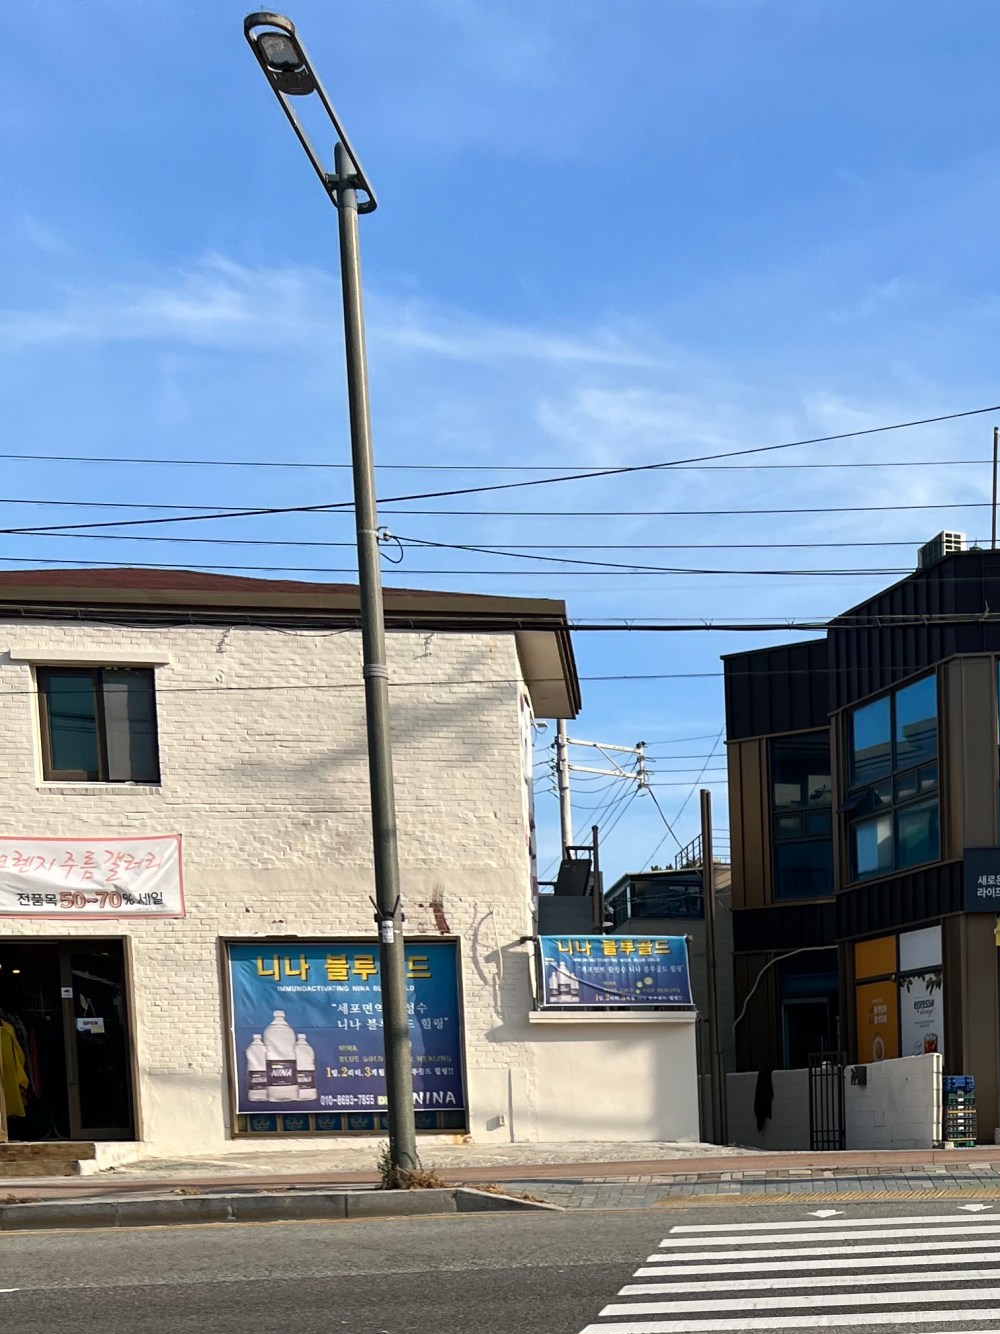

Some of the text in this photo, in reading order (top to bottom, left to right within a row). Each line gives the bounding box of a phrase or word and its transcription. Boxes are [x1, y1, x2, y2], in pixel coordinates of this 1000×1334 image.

[557, 939, 592, 956] 니나
[256, 954, 433, 982] 니나 블루드
